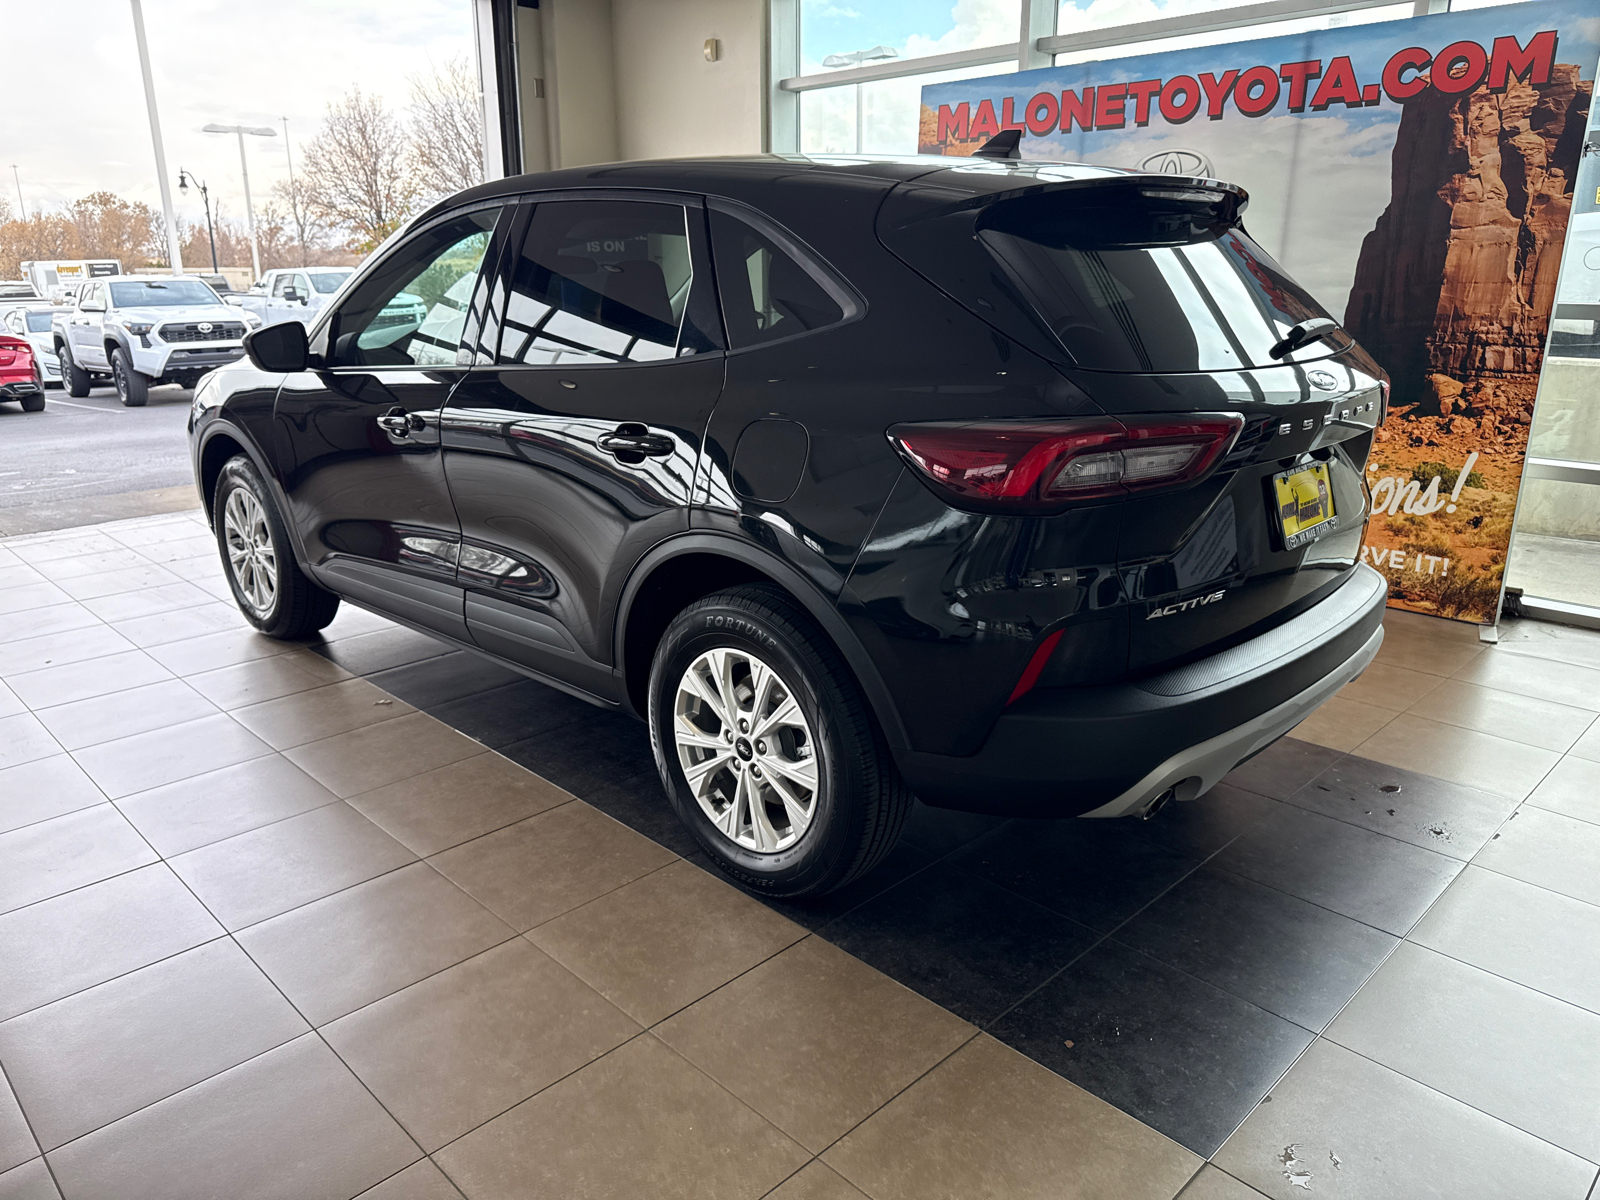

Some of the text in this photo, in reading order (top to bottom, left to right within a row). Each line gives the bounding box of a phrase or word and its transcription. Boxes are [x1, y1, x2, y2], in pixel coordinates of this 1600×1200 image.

[937, 30, 1558, 144] MALONETOYOTA.COM
[586, 240, 625, 253] IS ON
[1279, 401, 1374, 436] ESCAPE
[1369, 451, 1479, 516] ons!
[1415, 553, 1450, 577] IT!
[1145, 589, 1226, 620] ACTIVE
[705, 615, 777, 650] FORTUNE
